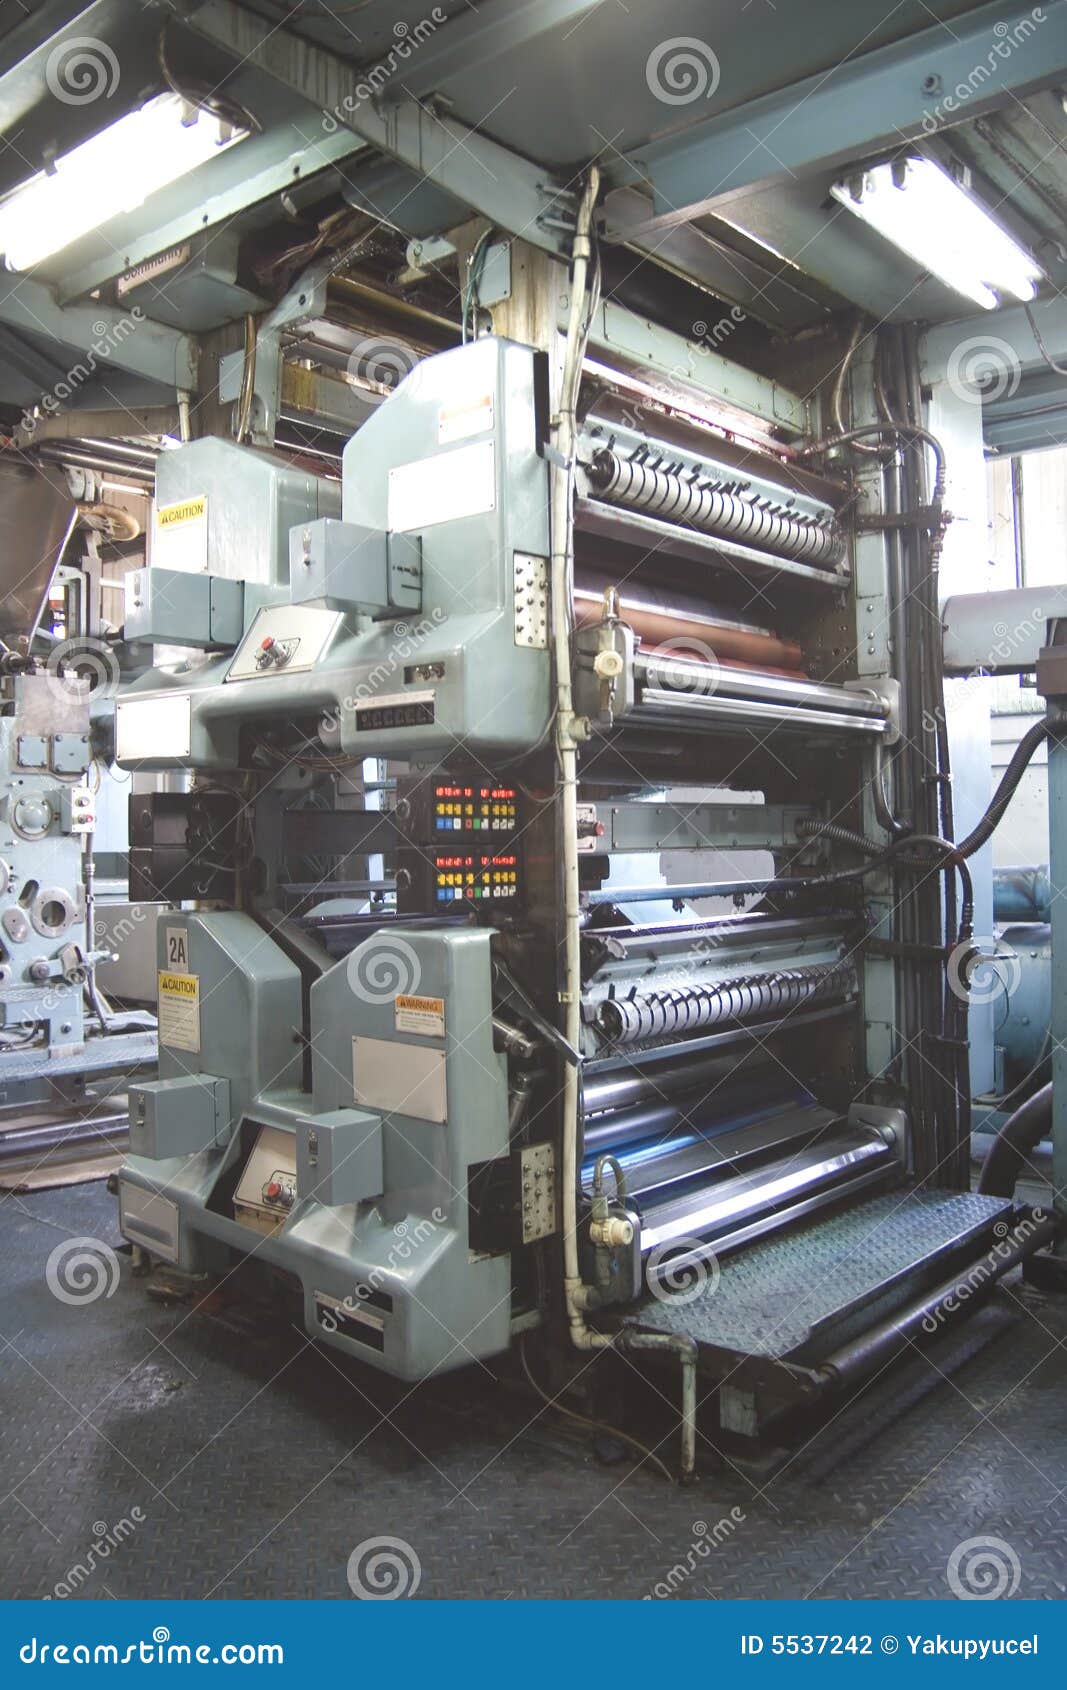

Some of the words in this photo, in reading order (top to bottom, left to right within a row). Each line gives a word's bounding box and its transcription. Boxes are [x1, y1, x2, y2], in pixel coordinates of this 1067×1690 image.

[169, 504, 203, 522] CAUTION
[169, 937, 186, 963] 2A
[167, 979, 196, 994] CAUTION
[406, 999, 439, 1012] WARNING
